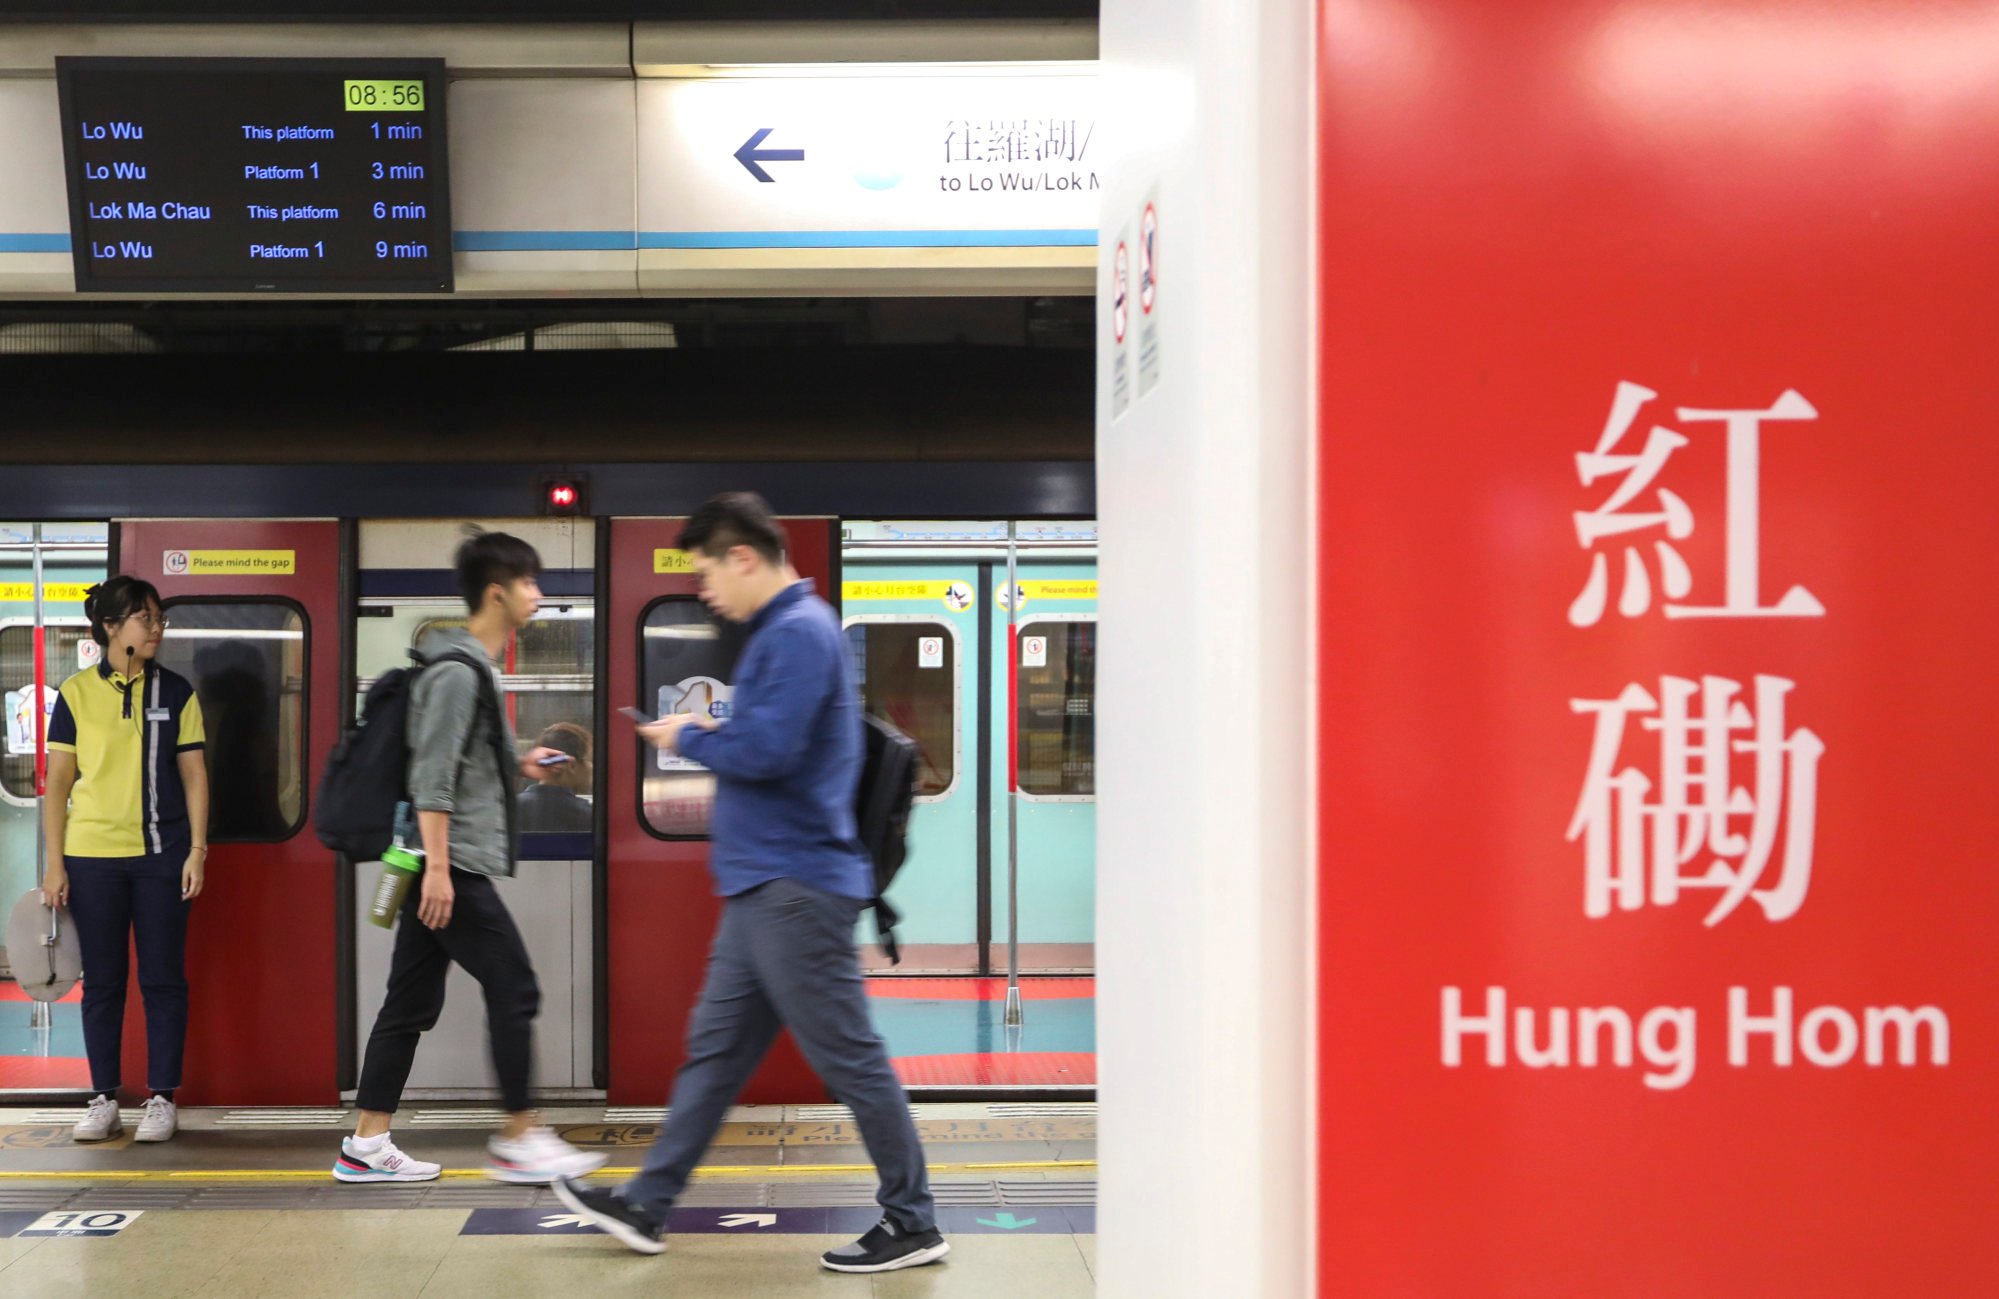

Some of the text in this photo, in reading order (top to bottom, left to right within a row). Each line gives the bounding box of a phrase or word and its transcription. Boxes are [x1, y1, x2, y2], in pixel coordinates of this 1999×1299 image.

[349, 84, 421, 106] 08:56
[82, 122, 422, 142] Lo Wu This platform 1 min
[85, 161, 424, 180] Lo Wu Platform 1 3 min
[939, 175, 962, 192] to
[969, 173, 994, 192] Lo
[999, 171, 1083, 192] Wu/Lok
[89, 201, 426, 222] Lok Ma Chau This platform 6 min
[92, 240, 428, 259] Lo Wu Platform 1 9 min
[193, 558, 290, 568] Please mind the gap
[1041, 586, 1065, 594] Please
[1067, 586, 1089, 594] mind
[1566, 380, 1827, 928] 紅磡
[1442, 986, 1951, 1090] Hung Hom
[54, 1213, 127, 1228] 10
